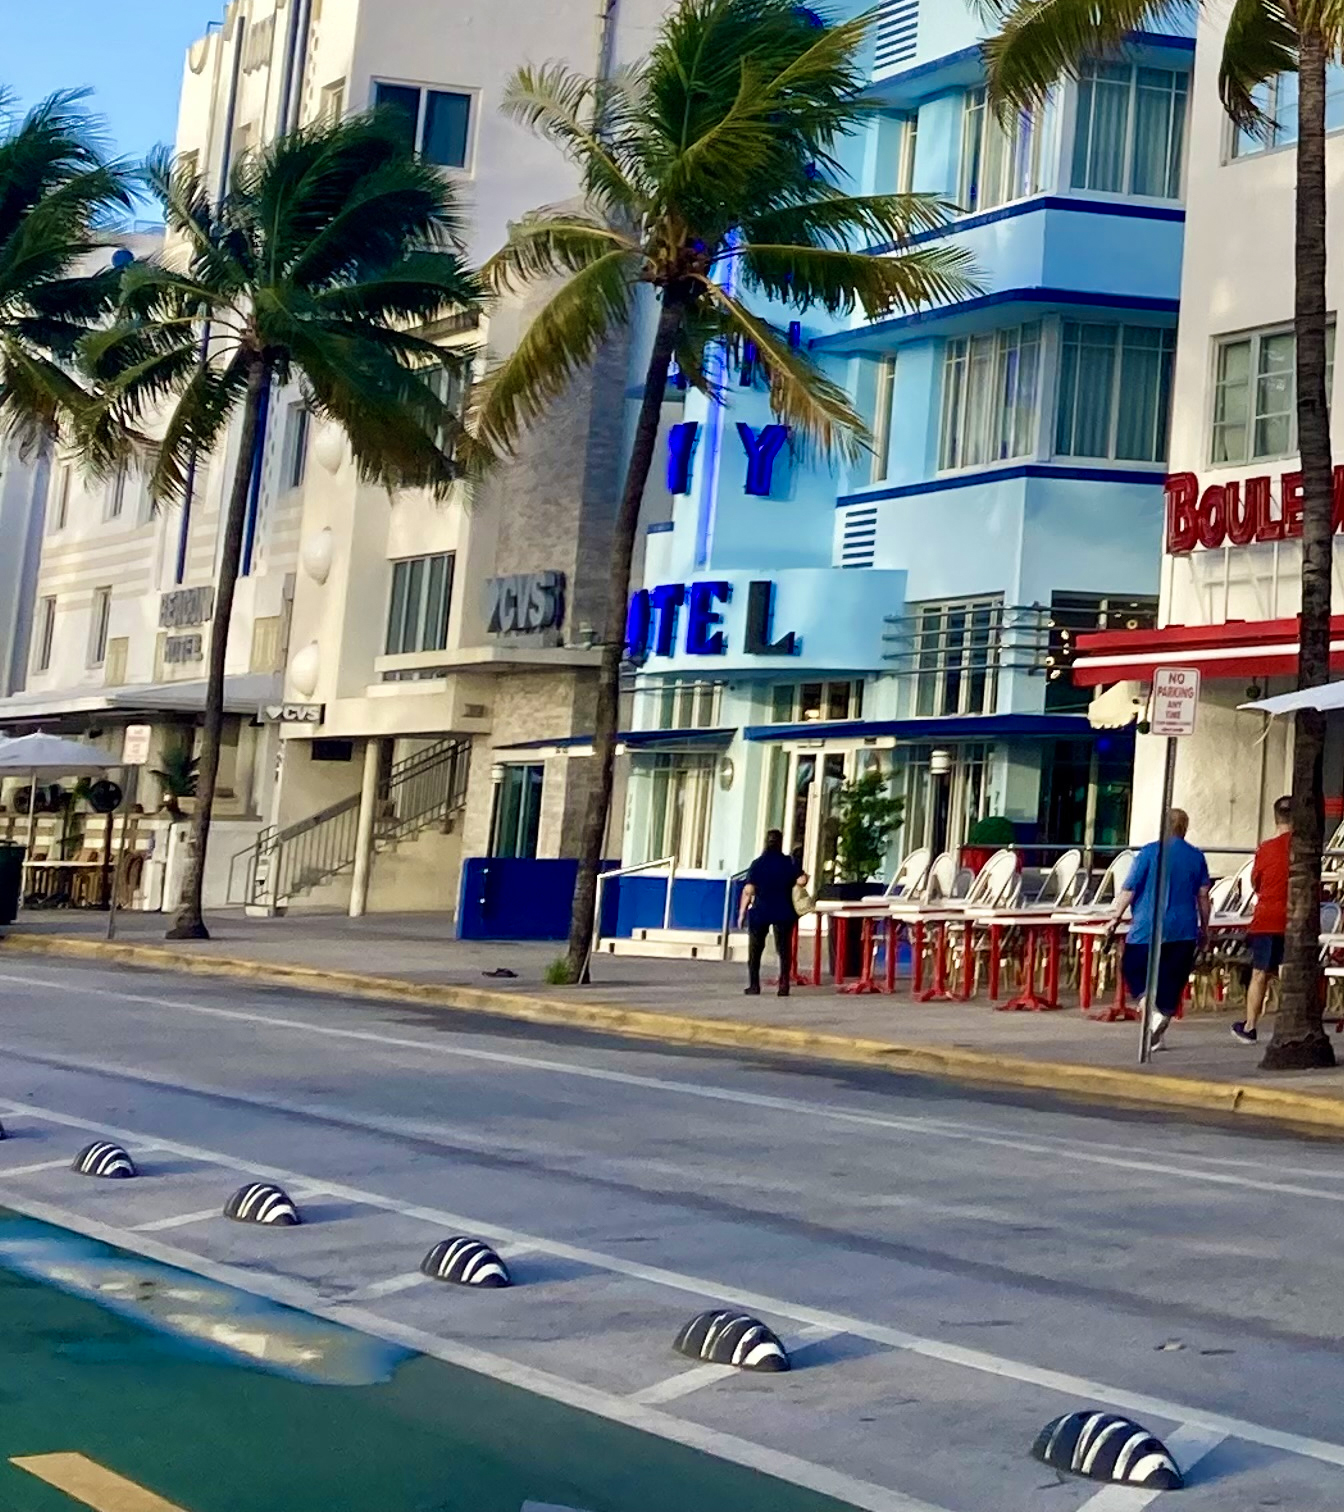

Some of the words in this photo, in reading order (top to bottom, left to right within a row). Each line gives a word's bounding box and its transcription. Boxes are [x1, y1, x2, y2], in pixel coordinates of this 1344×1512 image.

[498, 572, 560, 634] CVS
[625, 580, 798, 660] OTEL
[1167, 672, 1186, 685] NO
[1156, 686, 1195, 699] PARKING
[1167, 700, 1183, 708] ANY
[282, 705, 320, 721] CVS
